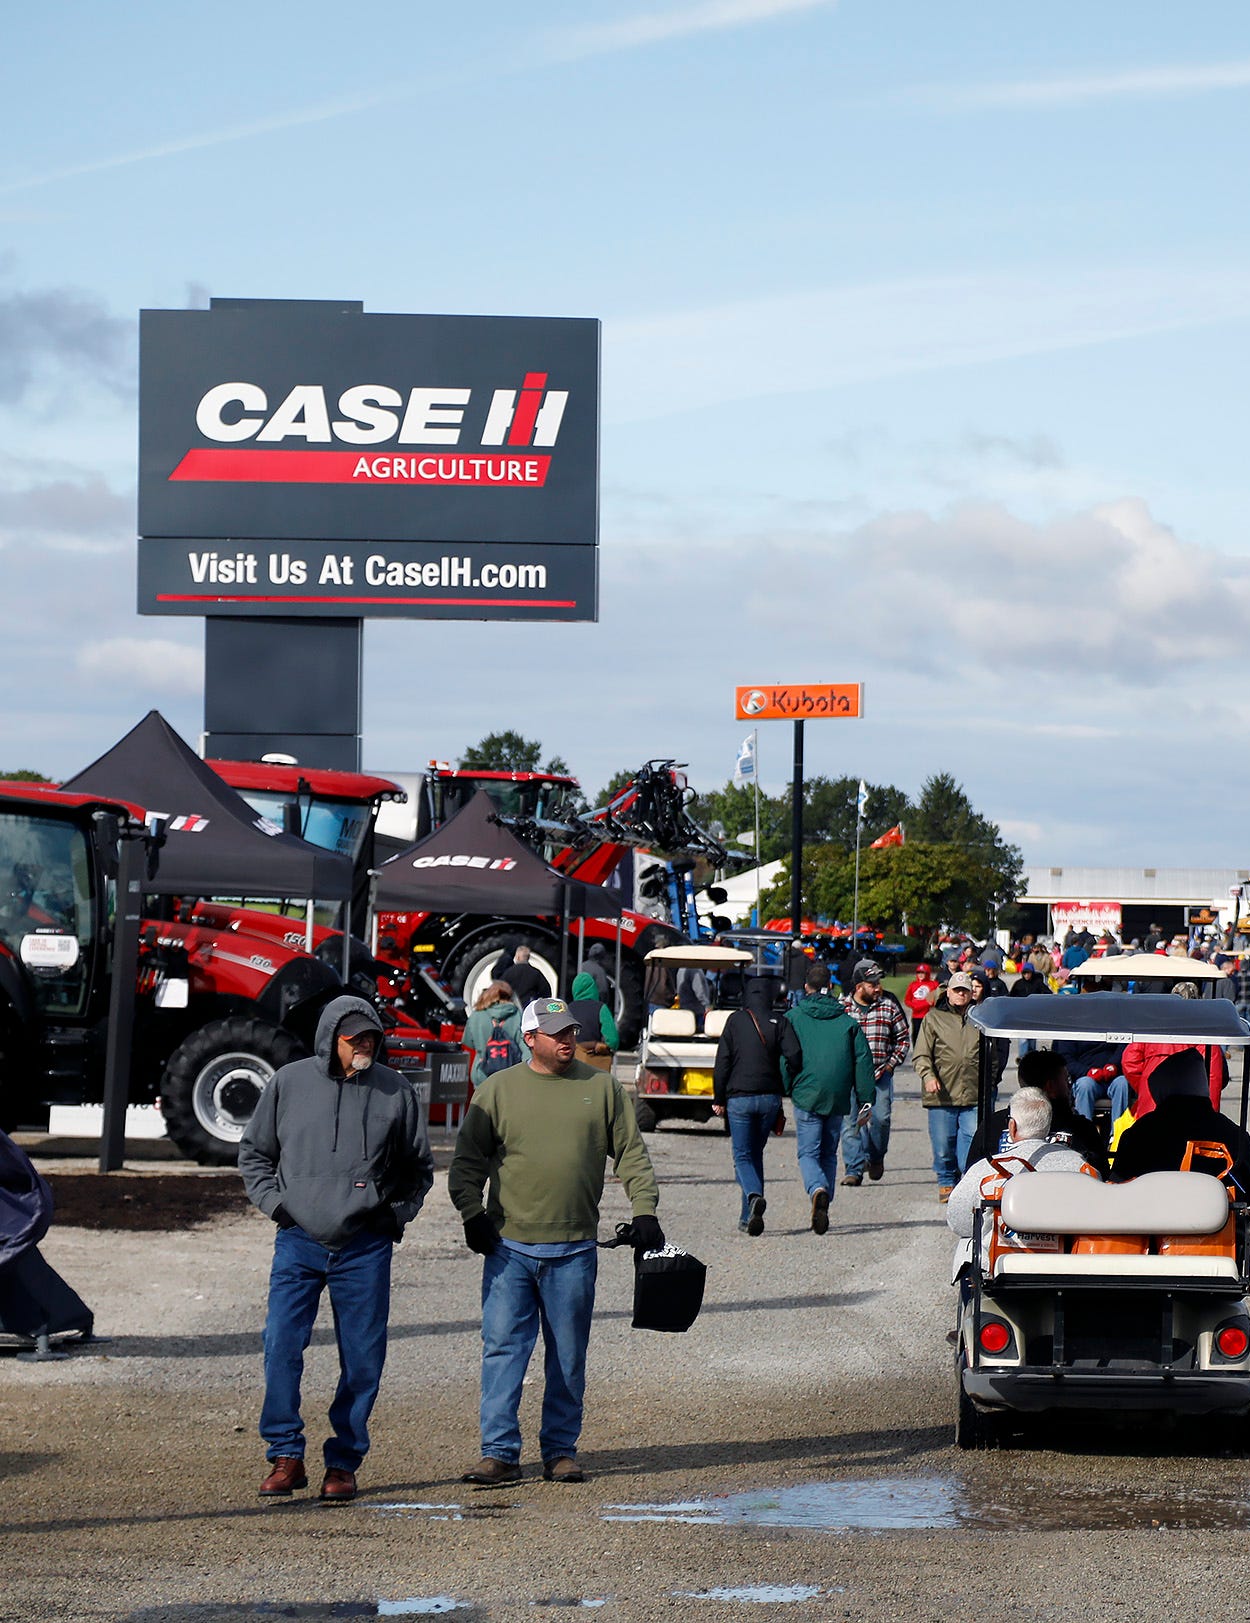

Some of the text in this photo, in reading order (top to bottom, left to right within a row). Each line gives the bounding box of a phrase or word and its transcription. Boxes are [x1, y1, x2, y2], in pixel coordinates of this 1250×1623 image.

[195, 382, 472, 446] CASE
[352, 456, 538, 482] AGRICULTURE
[188, 552, 546, 589] Visit Us At CaseIH.com
[772, 689, 850, 713] Kubota
[412, 855, 490, 869] CASE
